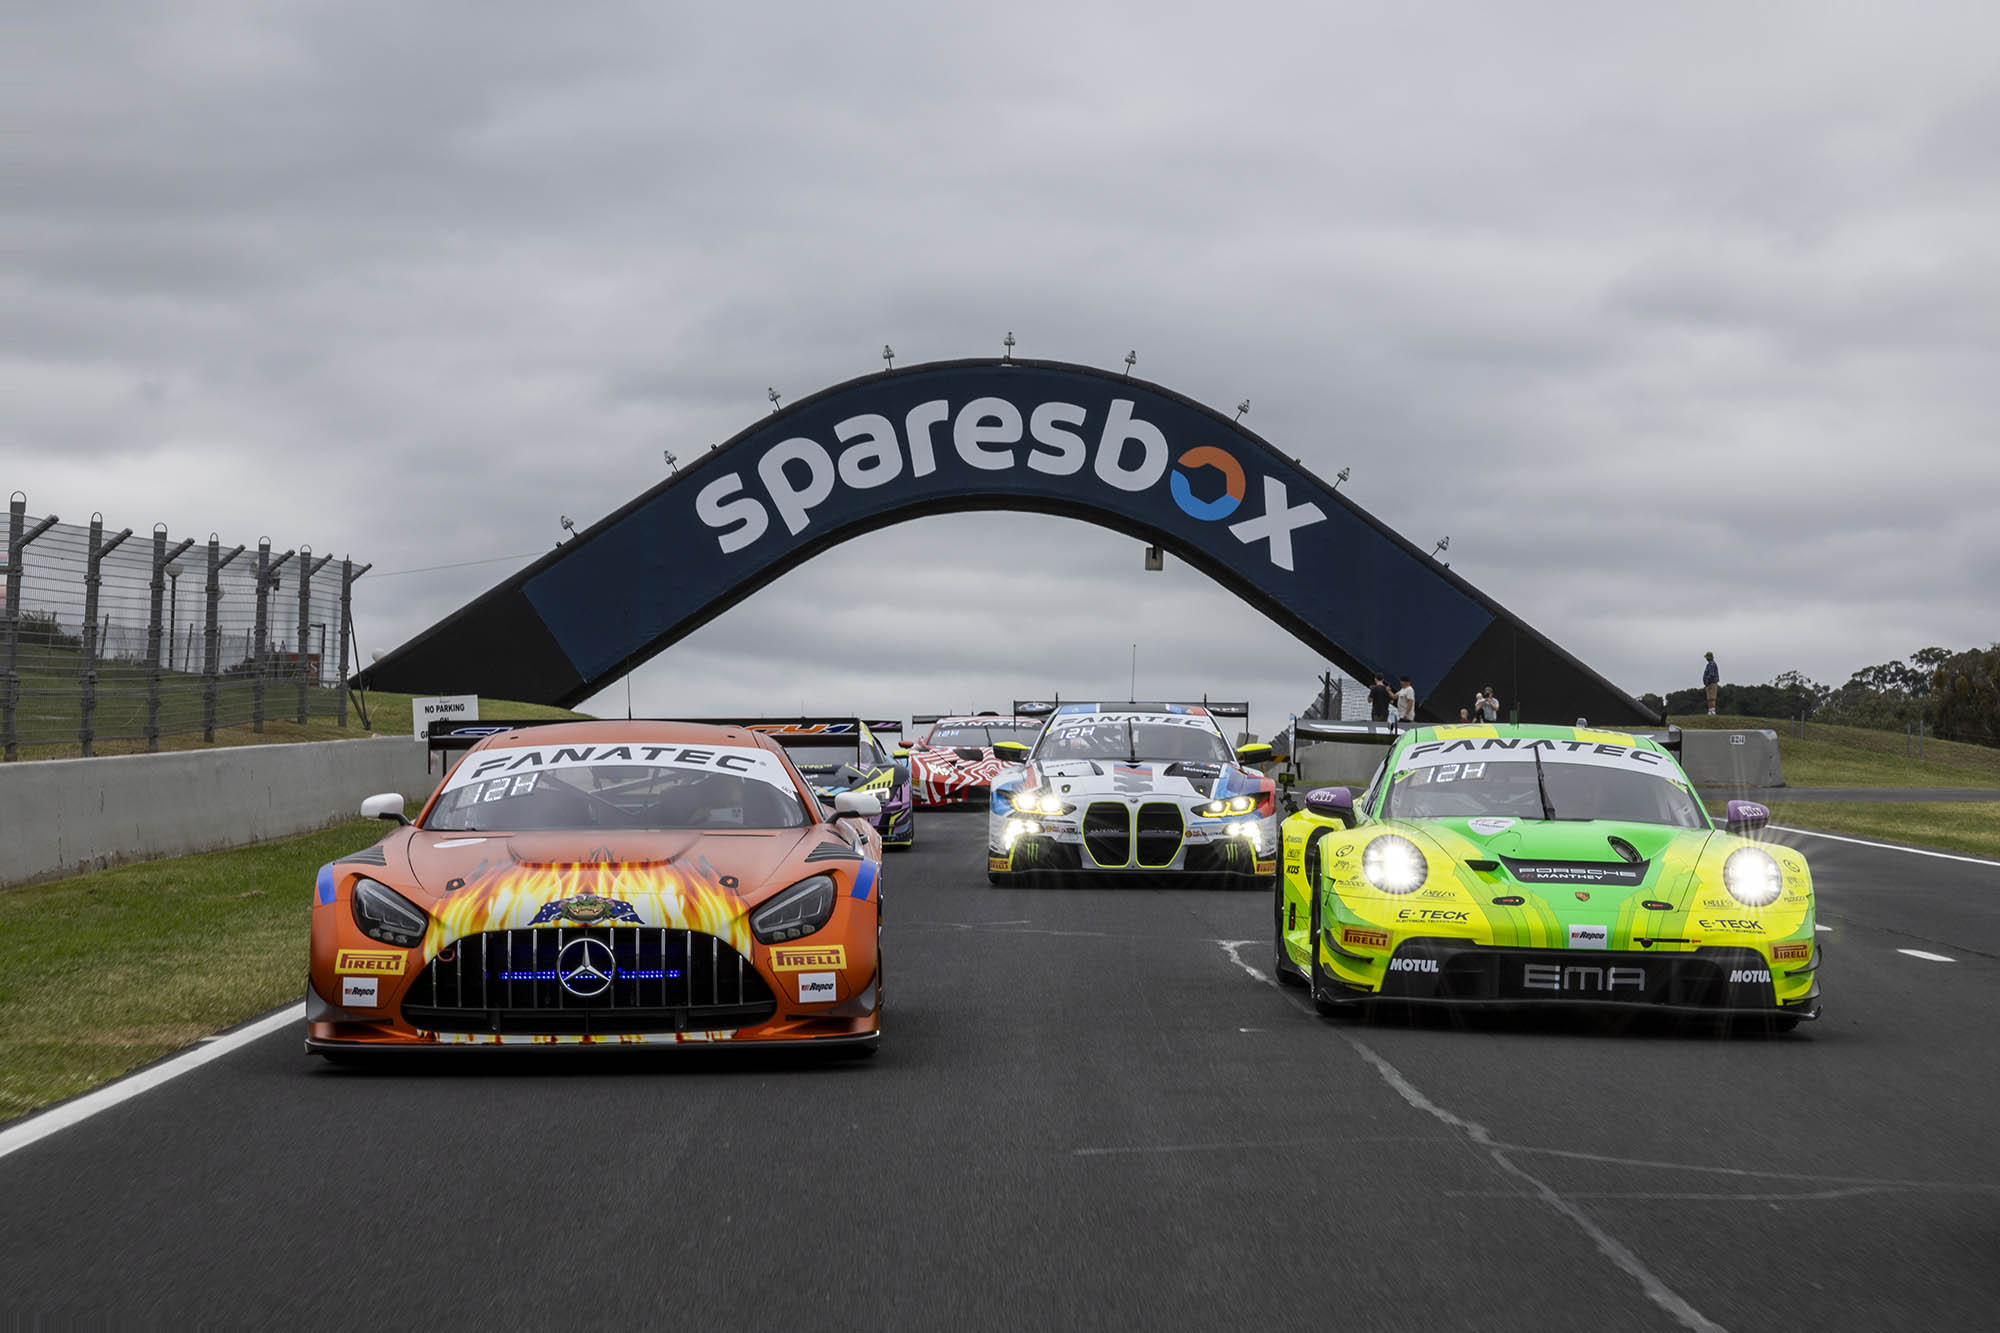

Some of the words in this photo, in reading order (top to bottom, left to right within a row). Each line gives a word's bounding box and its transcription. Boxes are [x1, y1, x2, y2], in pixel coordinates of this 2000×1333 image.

[696, 397, 1327, 572] sparesbox
[425, 705, 435, 714] NO
[436, 703, 465, 713] PARKING
[1056, 710, 1207, 727] FANATEC
[1060, 726, 1096, 739] 12H
[1409, 738, 1664, 765] FANATEC
[471, 746, 756, 779] FANATEC
[1427, 763, 1486, 783] 12H
[473, 773, 539, 802] 12H
[1519, 867, 1637, 878] PORSCHE
[1344, 929, 1388, 946] PIRELLI
[1579, 931, 1605, 940] Repco
[776, 949, 840, 966] PIRELLI
[1773, 944, 1808, 959] PIRELLI
[340, 953, 402, 970] PIRELLI
[1390, 958, 1439, 973] MOTUL
[1524, 964, 1645, 991] EMA
[1730, 970, 1771, 983] MOTUL
[351, 986, 376, 997] Repco
[810, 982, 834, 992] Repco
